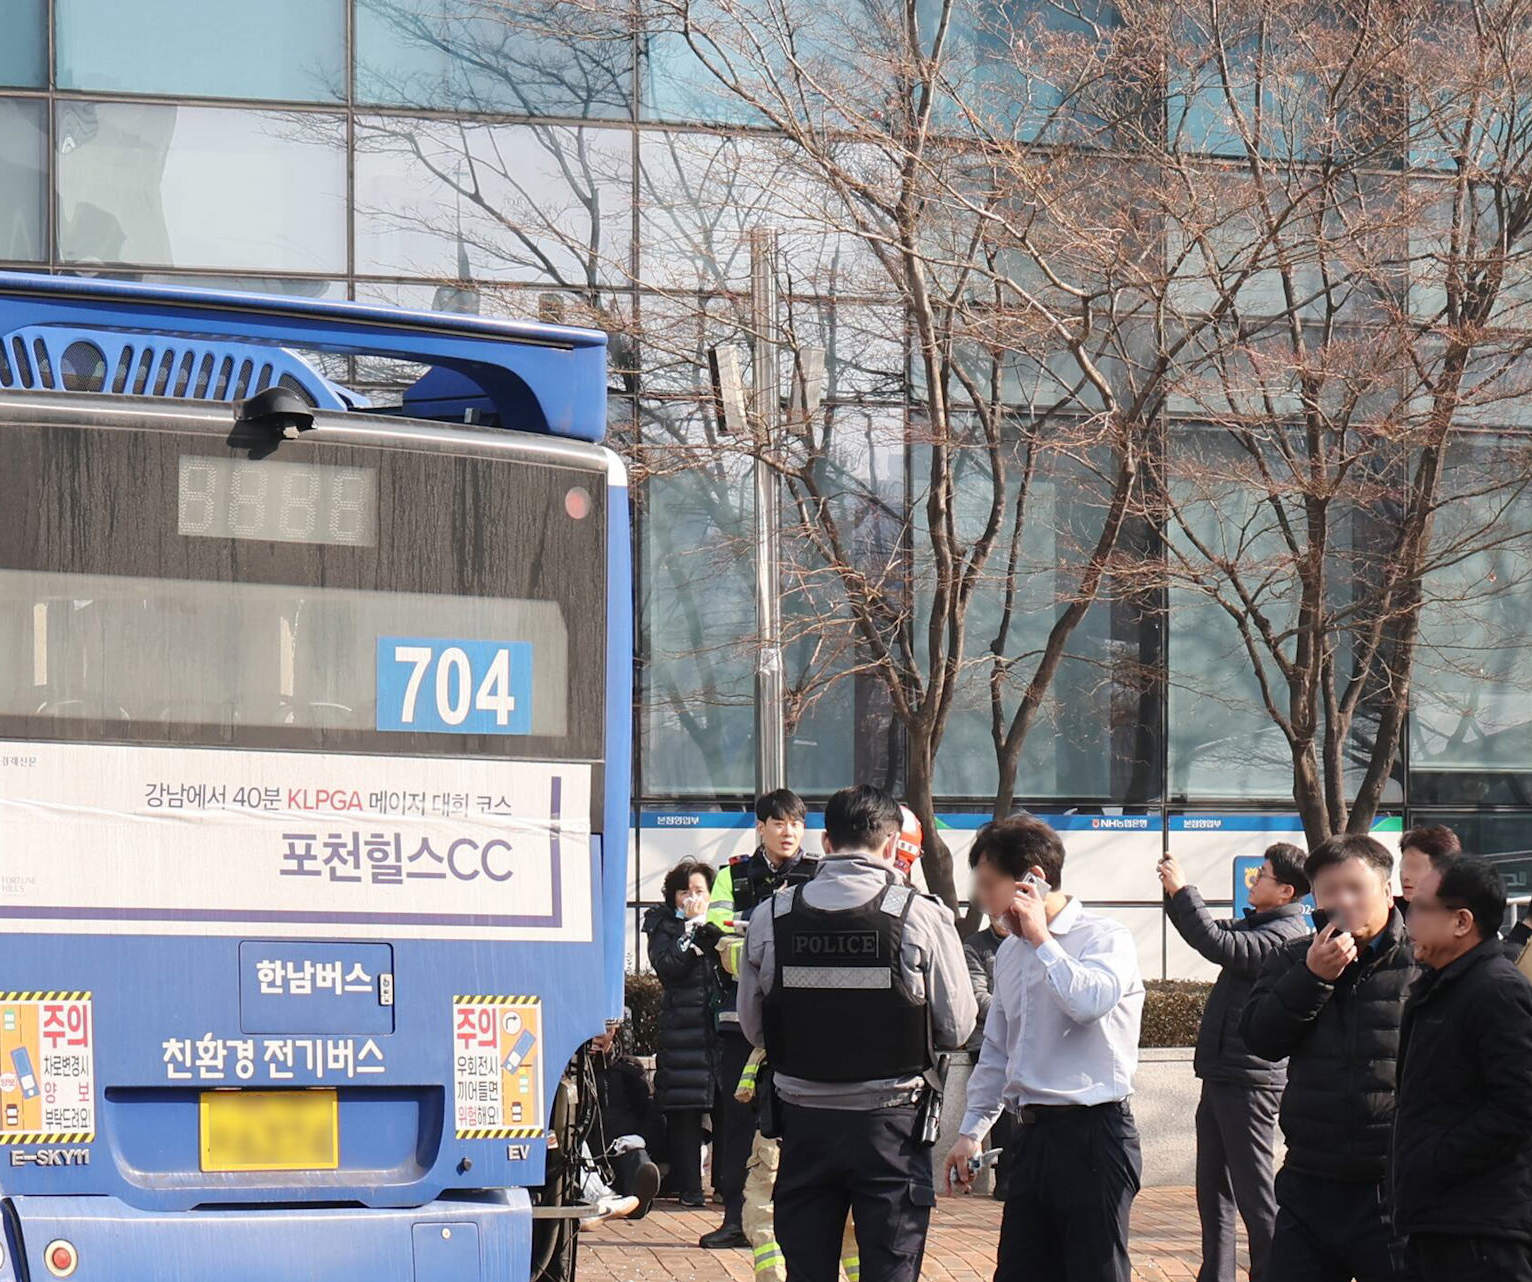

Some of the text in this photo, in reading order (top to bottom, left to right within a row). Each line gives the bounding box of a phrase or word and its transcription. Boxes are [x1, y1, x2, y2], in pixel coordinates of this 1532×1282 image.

[395, 646, 515, 725] 704
[145, 783, 512, 817] 강남에서 40분 KLPGA 메이저 대회 코스
[279, 831, 514, 885] 포천힐스CC
[795, 935, 876, 953] POLICE
[255, 959, 373, 996] 한남버스
[43, 1004, 89, 1049] 주의
[456, 1008, 497, 1049] 주의
[43, 1055, 90, 1078] 차로변경시
[161, 1032, 386, 1080] 친환경 전기버스
[457, 1055, 499, 1077] 우회전시
[457, 1081, 499, 1102] 끼어들면
[458, 1105, 500, 1127] 위험해요!
[508, 1144, 530, 1161] EV
